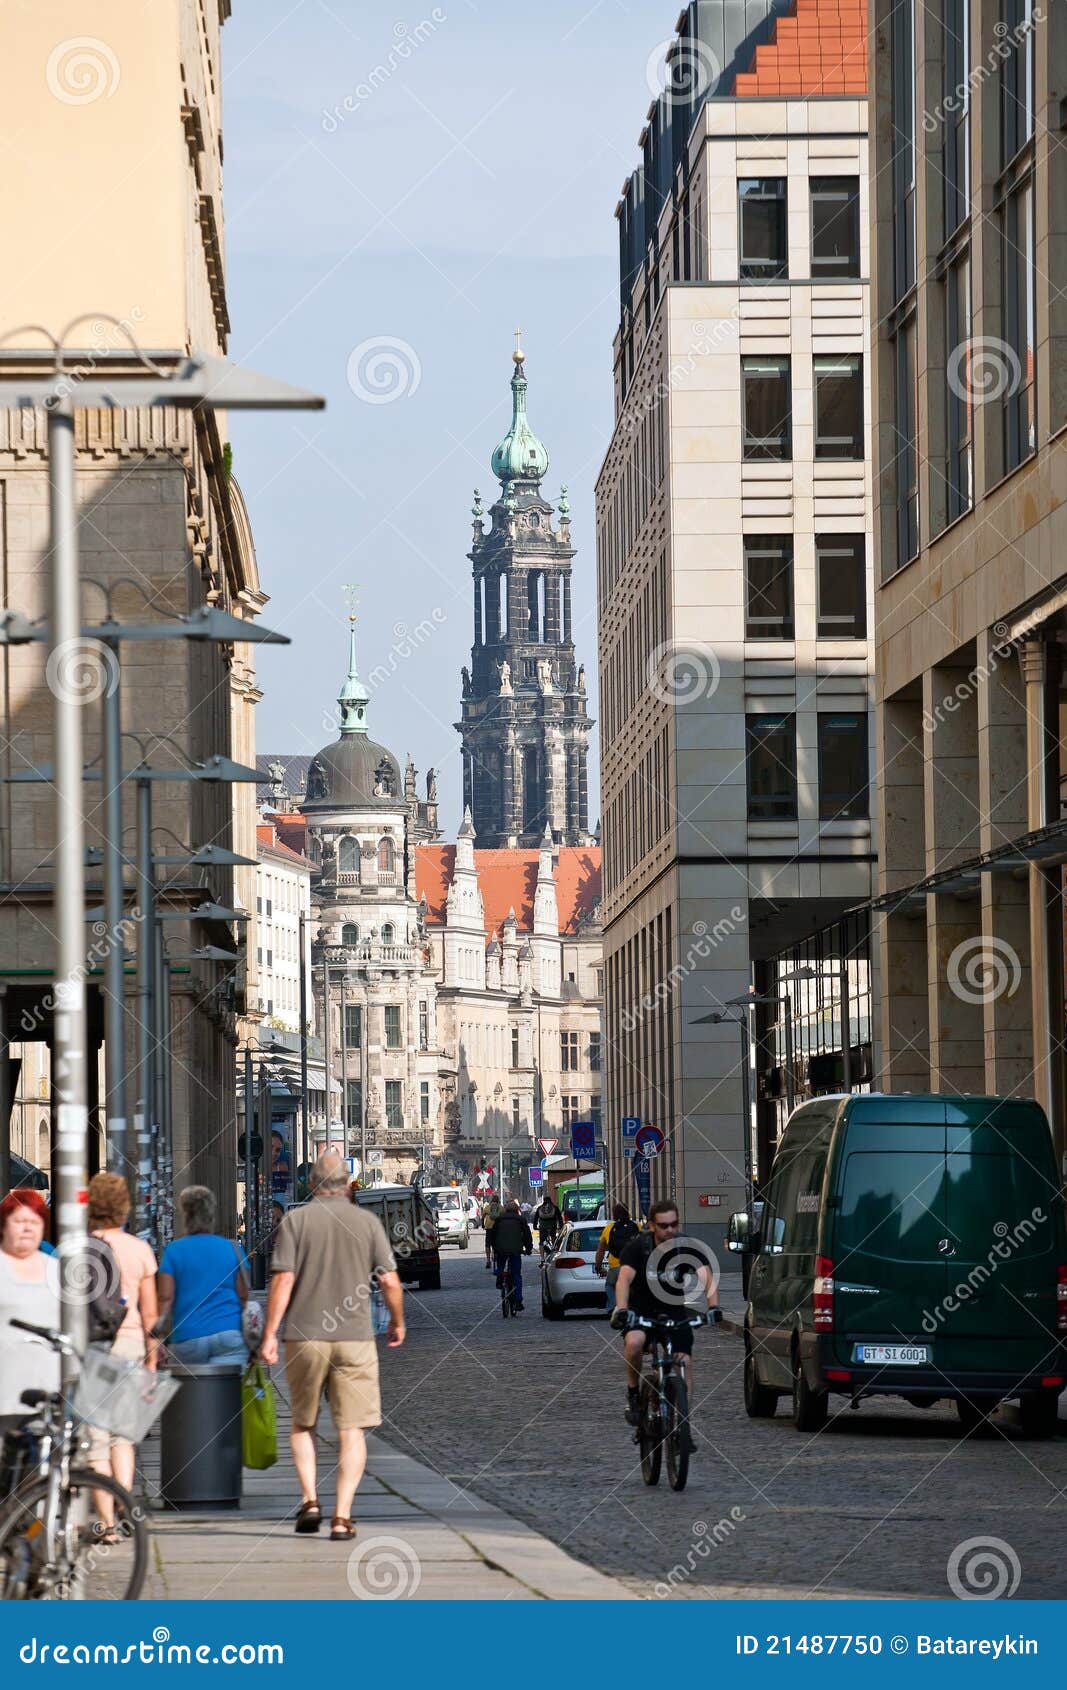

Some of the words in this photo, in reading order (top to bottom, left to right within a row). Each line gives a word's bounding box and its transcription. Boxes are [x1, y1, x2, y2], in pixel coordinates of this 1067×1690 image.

[626, 1120, 637, 1135] P
[575, 1147, 594, 1156] TAXI
[900, 1349, 925, 1361] 6001
